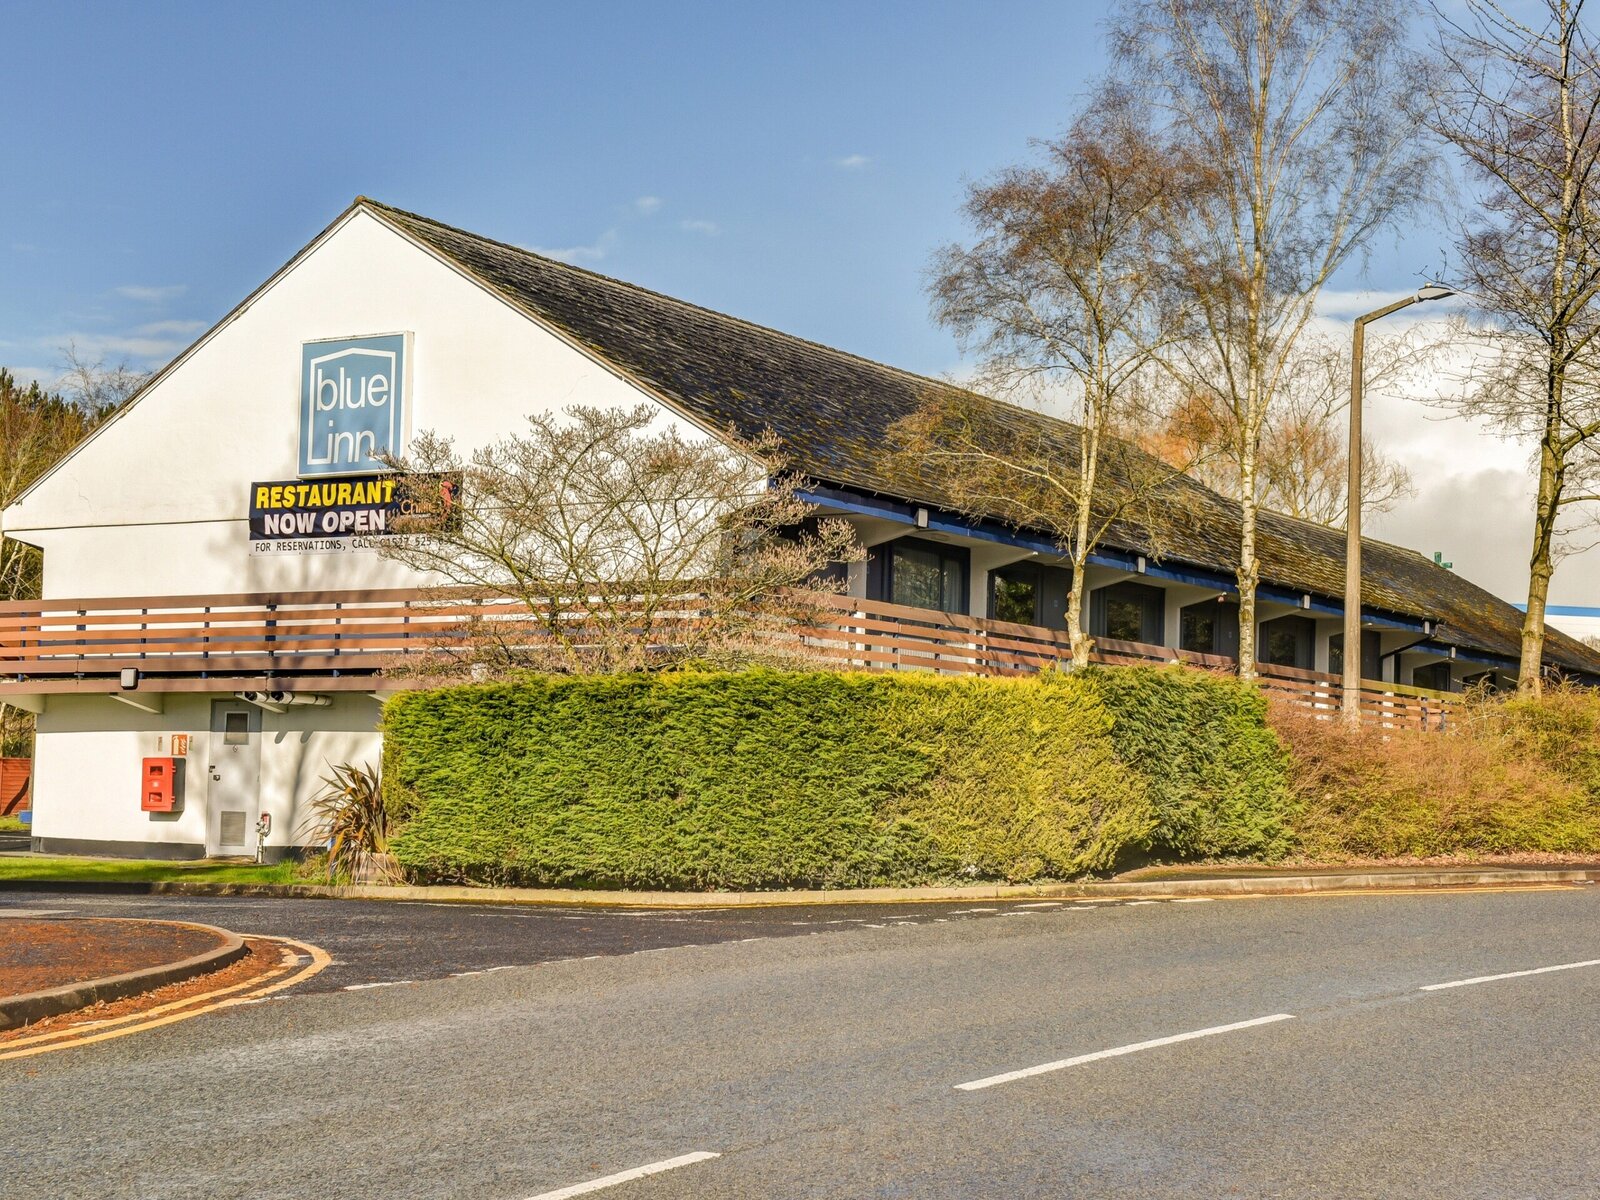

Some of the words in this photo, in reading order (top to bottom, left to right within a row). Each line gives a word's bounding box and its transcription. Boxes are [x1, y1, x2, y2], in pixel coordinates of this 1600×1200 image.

[316, 367, 389, 411] blue
[326, 420, 377, 464] inn
[256, 480, 395, 509] RESTAURANT
[264, 512, 317, 535] NOW
[322, 509, 386, 533] OPEN
[255, 542, 271, 552] FOR
[276, 540, 347, 551] RESERVATIONS,
